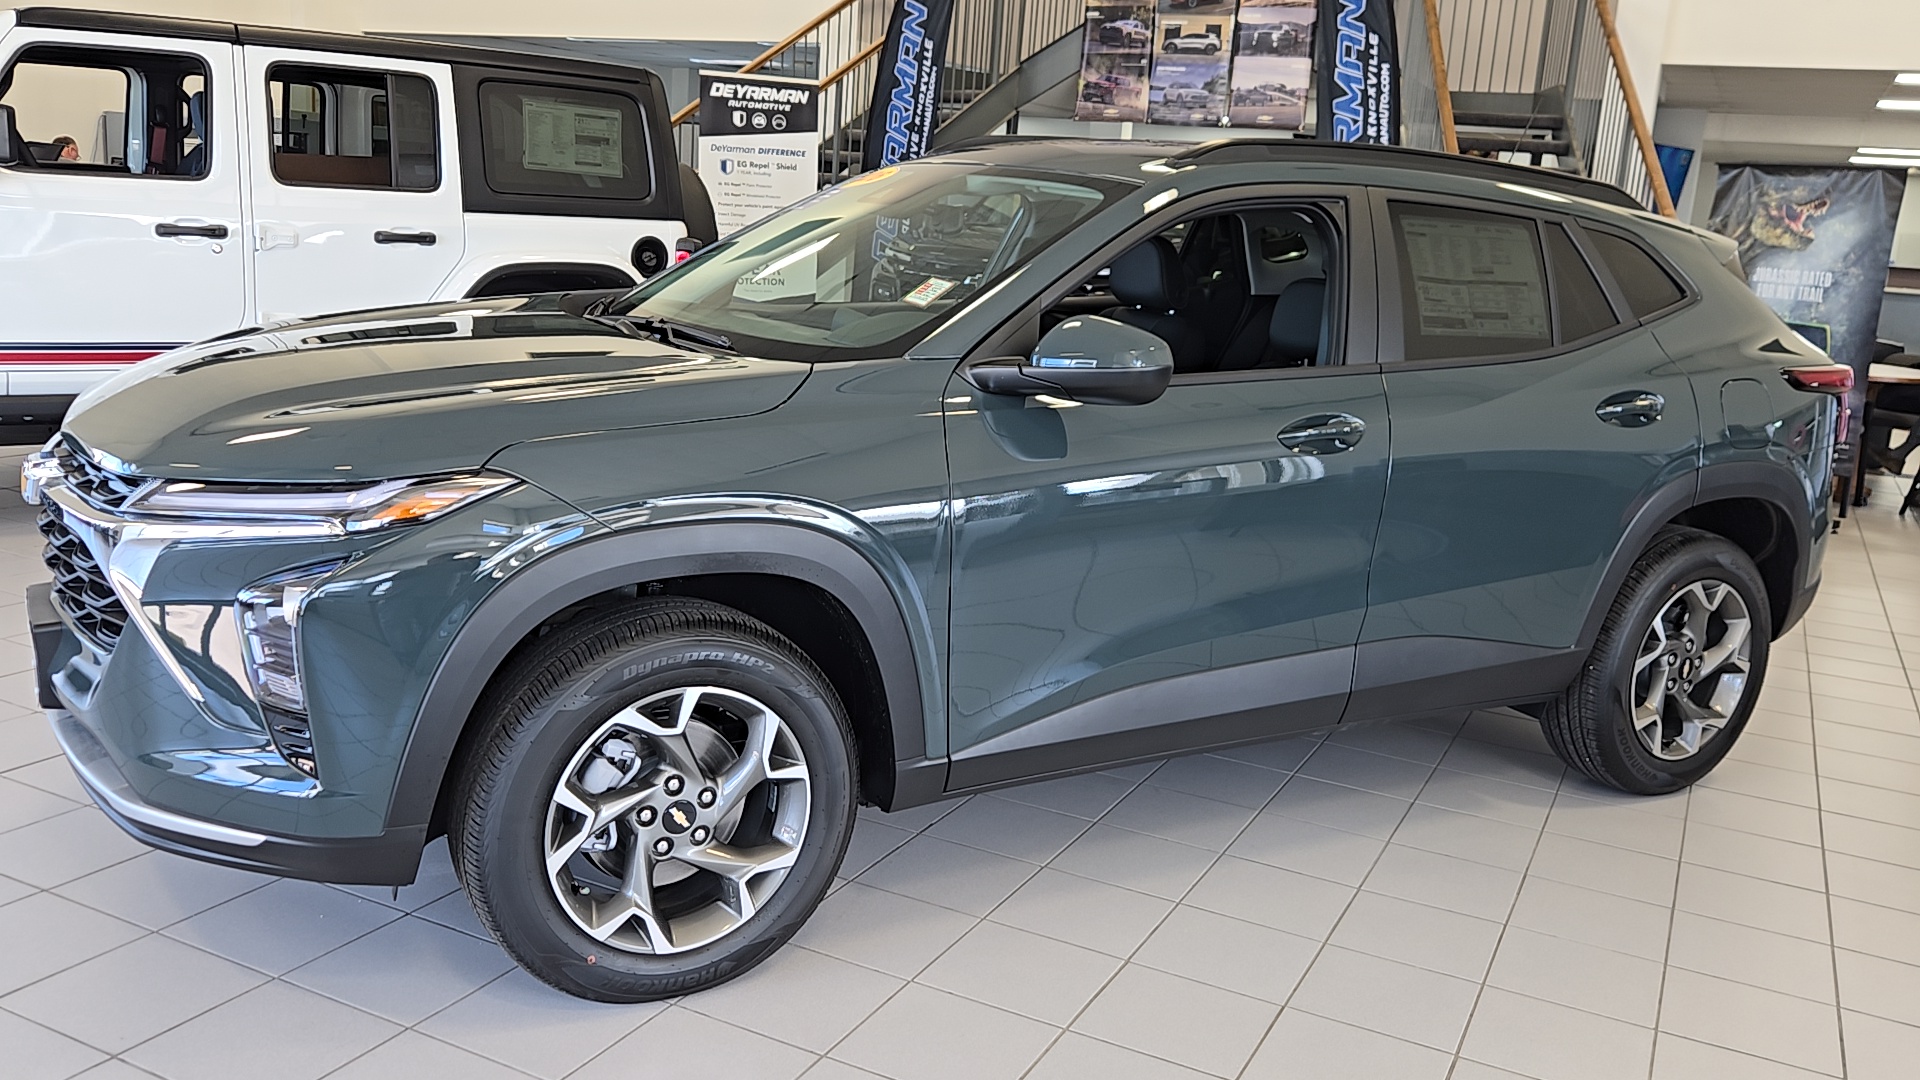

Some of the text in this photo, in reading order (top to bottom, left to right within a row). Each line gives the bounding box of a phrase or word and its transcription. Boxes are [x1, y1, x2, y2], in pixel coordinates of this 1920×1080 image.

[709, 82, 810, 104] DEYARMAN
[880, 0, 928, 167] ARMAN
[914, 37, 934, 125] KNOXVILLE
[1366, 31, 1379, 137] KNOXVILLE
[727, 99, 792, 112] AUTOMOTIVE
[919, 66, 938, 159] ARMANAUTO.COM
[711, 144, 807, 158] DeYarman DIFFERENCE
[909, 131, 920, 161] IVE
[737, 160, 798, 171] EG Repel Shield
[623, 651, 775, 681] Dynapro HP2
